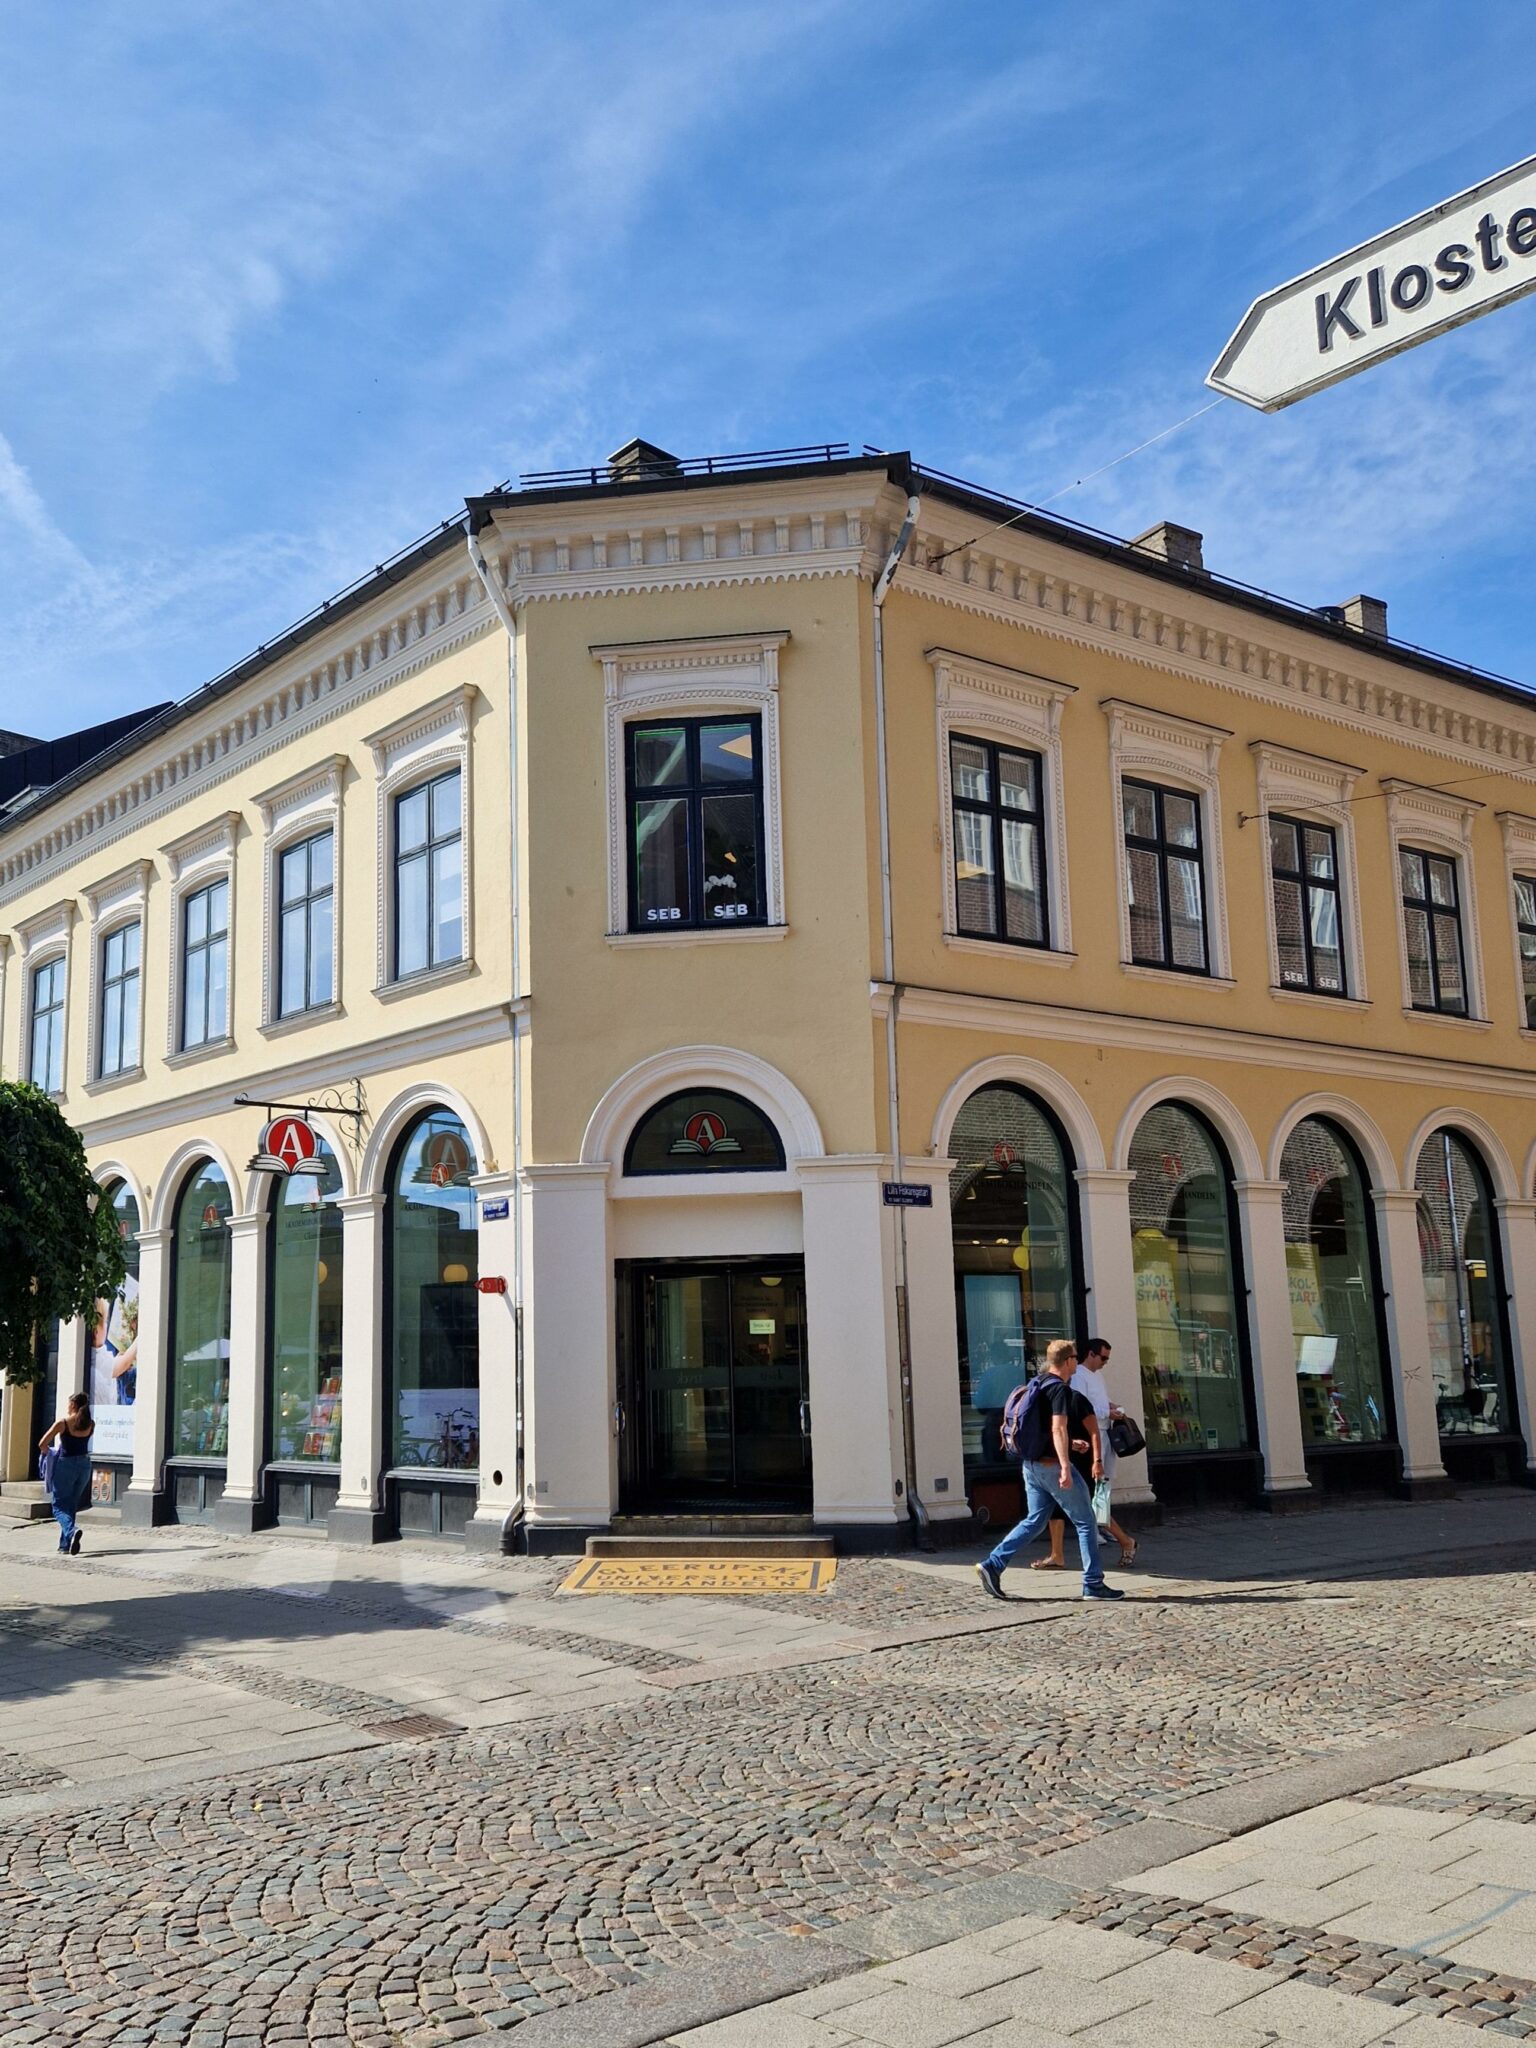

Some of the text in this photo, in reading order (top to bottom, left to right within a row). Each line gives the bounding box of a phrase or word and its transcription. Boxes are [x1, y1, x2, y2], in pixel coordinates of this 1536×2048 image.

[647, 907, 681, 921] SEB
[714, 903, 748, 917] SEB
[1284, 971, 1304, 983] SEB
[1320, 977, 1338, 989] SEB
[696, 1117, 717, 1143] A
[278, 1123, 305, 1161] A
[1289, 1276, 1315, 1289] KOL-
[1137, 1289, 1174, 1301] START
[1289, 1291, 1317, 1304] TART
